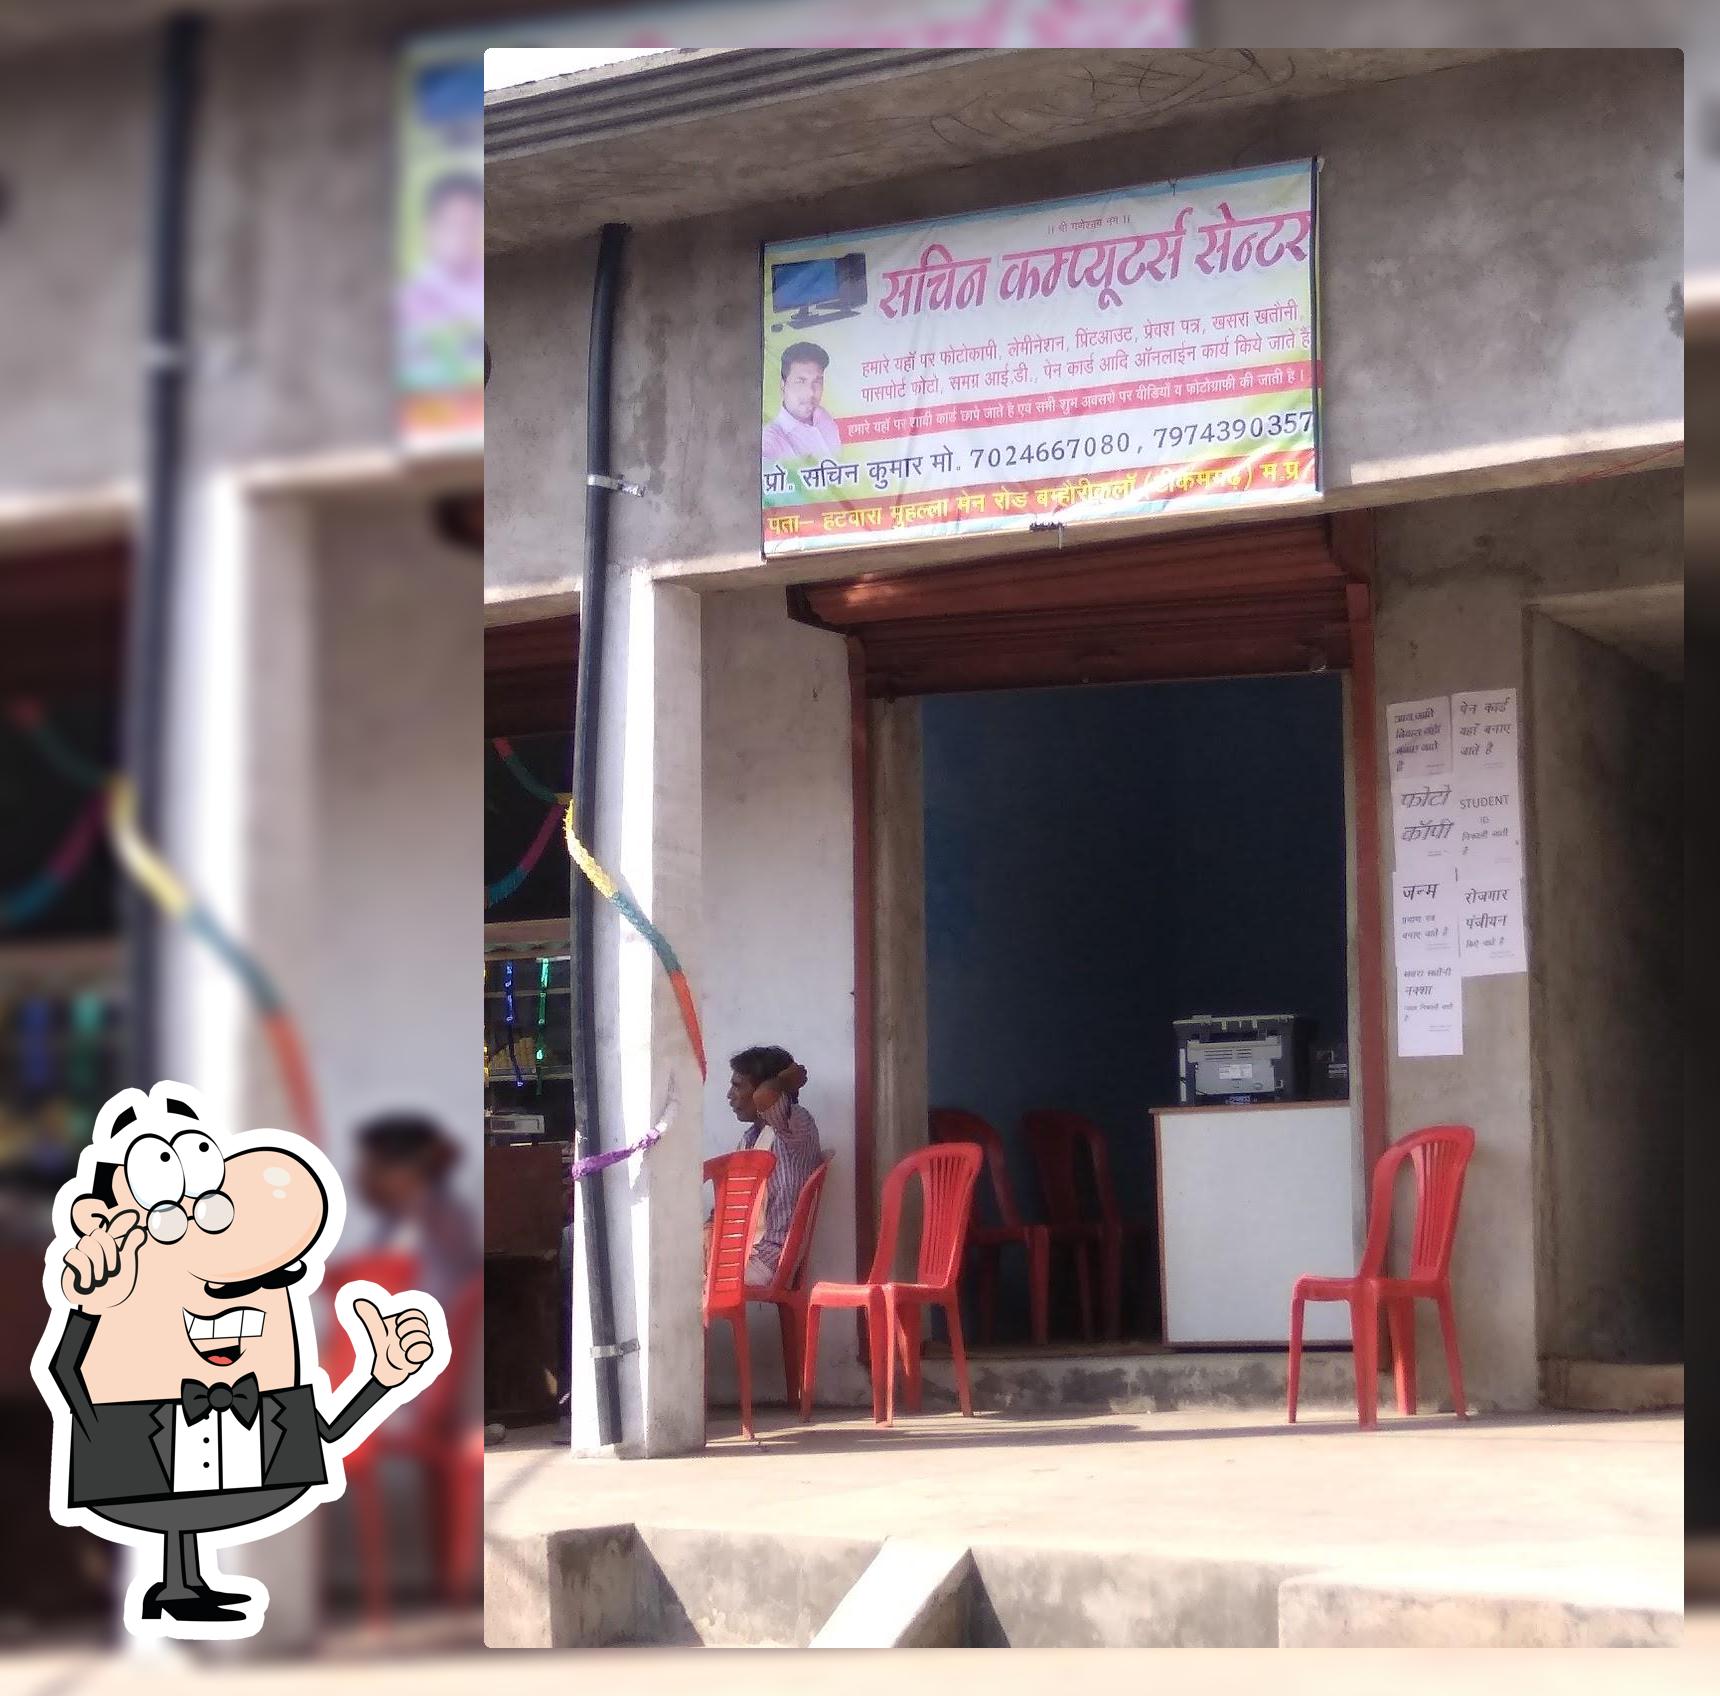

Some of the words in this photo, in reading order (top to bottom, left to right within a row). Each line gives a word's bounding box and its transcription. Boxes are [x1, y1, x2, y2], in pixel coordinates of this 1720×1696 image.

[879, 244, 992, 319] सचिन
[999, 206, 1194, 310] कम्प्यूटर्स
[1194, 202, 1312, 275] सेन्टर
[861, 353, 890, 378] हमारे
[920, 352, 935, 369] पर
[1212, 311, 1249, 331] खसरा
[861, 377, 906, 403] पासपोर्ट
[949, 372, 980, 391] समग्र
[1043, 358, 1062, 380] पेन
[1067, 352, 1095, 377] कार्ड
[1100, 349, 1130, 373] आदि
[1201, 335, 1229, 359] कार्य
[1234, 331, 1263, 357] किये
[1267, 327, 1296, 351] जाते
[847, 419, 870, 437] हमारे
[894, 418, 906, 431] पर
[984, 403, 1004, 419] जाते
[1119, 389, 1133, 403] पर
[1186, 374, 1236, 396] फोटोग्राफी
[1239, 372, 1254, 389] की
[1258, 367, 1283, 386] जाती
[800, 458, 860, 489] सचिन
[867, 455, 923, 490] कुमार
[930, 444, 961, 474] मो.
[1153, 411, 1313, 449] 7974390357
[822, 506, 882, 531] हटवारा
[891, 499, 948, 530] मुहल्ला
[956, 490, 987, 514] मेन
[992, 486, 1029, 511] रोड
[1459, 795, 1510, 810] STUDENT
[1401, 882, 1440, 901] जन्म
[1464, 887, 1511, 905] रोजगार
[1465, 912, 1508, 929] पंजीयन
